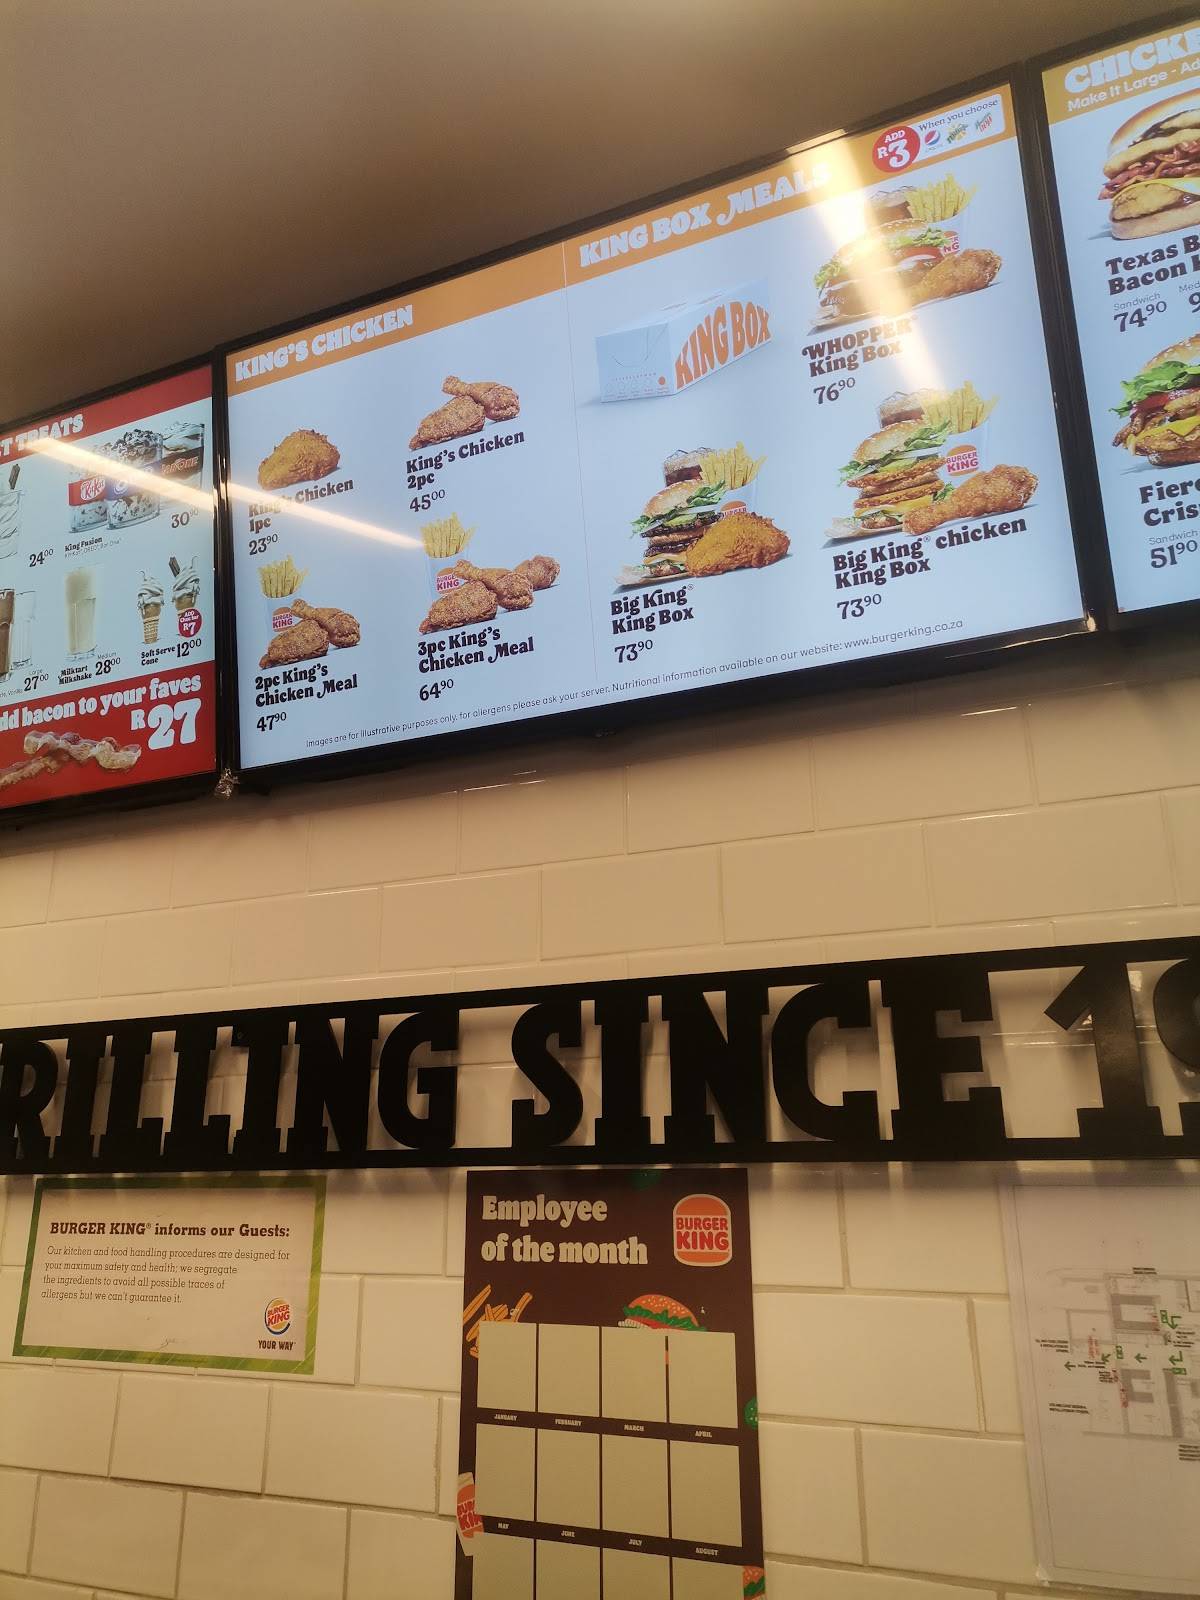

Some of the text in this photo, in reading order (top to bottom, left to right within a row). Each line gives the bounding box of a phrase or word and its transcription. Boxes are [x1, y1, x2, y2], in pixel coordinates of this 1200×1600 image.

[1067, 71, 1168, 112] Make It Large
[918, 117, 945, 132] When
[946, 111, 964, 124] you
[965, 99, 998, 116] choose
[884, 129, 906, 143] ADD
[579, 163, 832, 268] KING BOX MEALS
[1105, 244, 1179, 275] Texas
[1108, 262, 1188, 295] Bacon
[1113, 293, 1161, 311] Sandwich
[235, 304, 413, 383] KING'S CHICKEN
[675, 300, 772, 390] KING BOX
[809, 341, 904, 378] King Box
[15, 414, 84, 452] TREATS
[406, 429, 525, 475] King's Chicken
[946, 451, 977, 464] BURGER
[947, 458, 979, 473] KING
[407, 471, 435, 490] 2pc
[294, 480, 354, 504] Chicken
[1143, 501, 1200, 526] Cris
[249, 518, 272, 534] 1pc
[64, 542, 81, 554] King
[81, 537, 103, 548] Fusion
[832, 549, 867, 572] Big
[935, 518, 1027, 549] chicken
[1149, 529, 1199, 545] Sandwich
[835, 557, 931, 589] King Box
[437, 579, 460, 590] KING
[610, 594, 640, 616] Big
[273, 618, 293, 628] KING
[612, 606, 694, 635] King Box
[417, 626, 501, 657] 3pc King's
[141, 648, 155, 659] Soft
[155, 646, 176, 656] Serve
[418, 637, 534, 674] Chicken Meal
[141, 658, 160, 666] Cone
[58, 665, 88, 679] Milktart
[59, 672, 92, 685] Milkshake
[255, 663, 328, 692] 2pc King's
[334, 734, 347, 743] are
[348, 731, 359, 740] for
[360, 724, 401, 738] illustrative
[402, 717, 438, 732] purposes
[459, 711, 471, 720] for
[472, 704, 512, 717] allergens
[512, 699, 541, 712] please
[542, 694, 557, 705] ask
[558, 691, 579, 704] your
[612, 674, 661, 692] Nutritional
[662, 666, 717, 683] information
[719, 656, 763, 673] available
[764, 655, 778, 665] on
[780, 651, 797, 662] our
[799, 643, 843, 658] website:
[843, 619, 963, 650] www.burgerking.co.za
[255, 673, 358, 708] Chicken Meal
[22, 674, 201, 727] bacon to your faves
[511, 971, 1007, 1149] SINCE
[481, 1194, 608, 1228] Employee
[50, 1222, 106, 1235] BURGER
[154, 1223, 206, 1236] informs
[210, 1226, 235, 1237] our
[239, 1223, 290, 1237] Guests:
[675, 1217, 729, 1231] BURGER
[481, 1233, 649, 1265] of the month
[676, 1231, 729, 1251] KING
[47, 1245, 291, 1261] Our kitchen and food handling procedures are designed for
[44, 1262, 62, 1271] your
[63, 1261, 103, 1271] maximum
[104, 1262, 129, 1273] safety
[130, 1262, 146, 1272] and
[180, 1265, 193, 1273] we
[193, 1265, 238, 1276] segregate
[43, 1274, 225, 1289] the ingredients to avoid all possible traces of
[41, 1289, 78, 1301] allergens
[79, 1289, 93, 1299] but
[94, 1292, 106, 1300] we
[129, 1293, 172, 1303] guarantee
[267, 1304, 290, 1317] BURGER
[267, 1311, 290, 1327] KING
[258, 1340, 277, 1350] YOUR
[494, 1413, 518, 1422] JANUARY
[555, 1418, 582, 1427] FEBRUARY
[624, 1424, 645, 1432] MARCH
[695, 1430, 712, 1438] APRIL
[498, 1522, 510, 1530] MAY
[561, 1530, 575, 1538] JUNE
[628, 1538, 643, 1547] JULY
[695, 1547, 719, 1557] AUGUST
